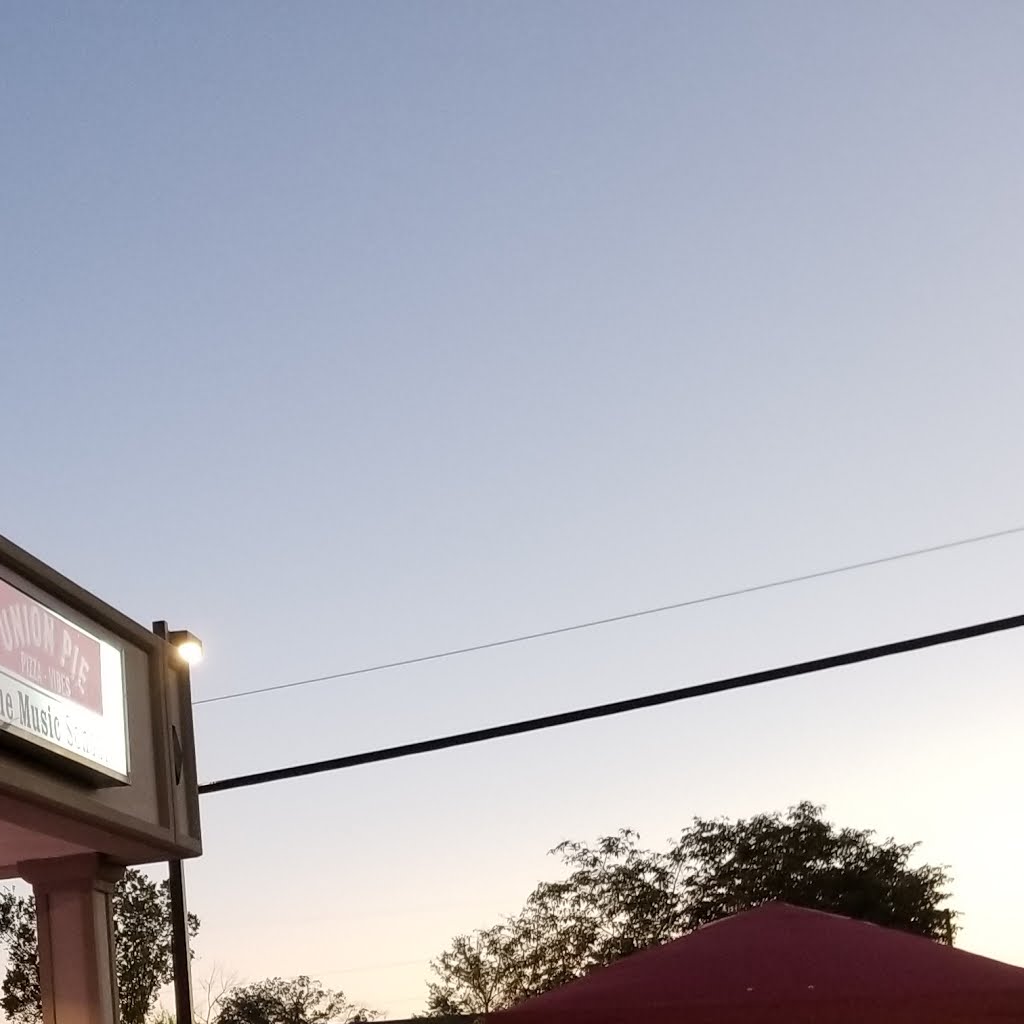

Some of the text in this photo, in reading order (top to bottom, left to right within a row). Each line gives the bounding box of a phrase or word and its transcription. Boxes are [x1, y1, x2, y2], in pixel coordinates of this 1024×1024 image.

[48, 665, 71, 697] VIBES
[60, 629, 90, 695] PIE
[17, 690, 61, 741] Music
